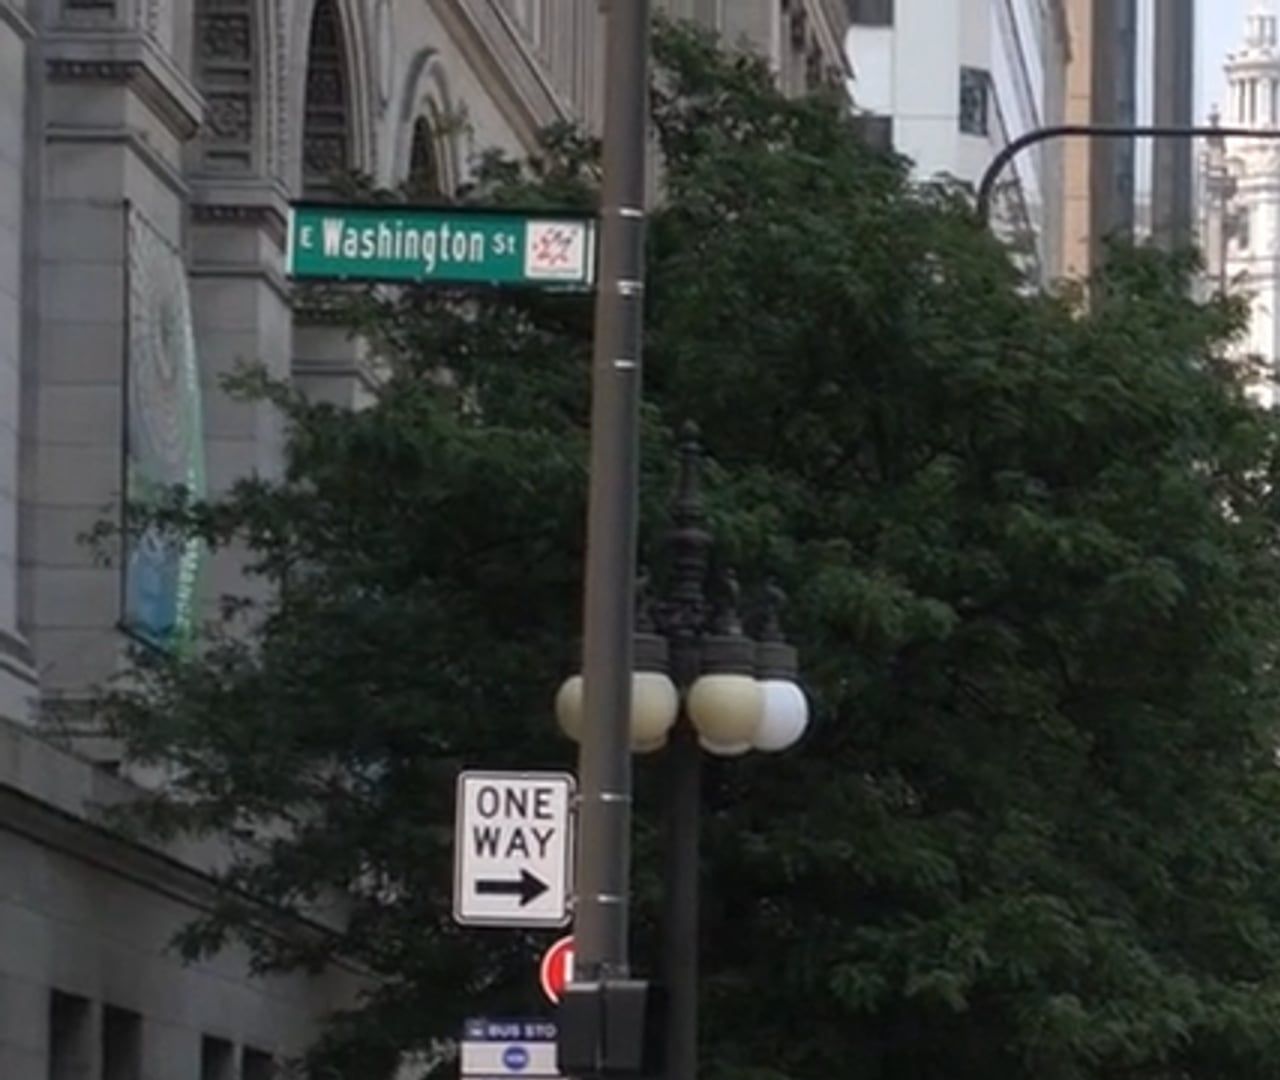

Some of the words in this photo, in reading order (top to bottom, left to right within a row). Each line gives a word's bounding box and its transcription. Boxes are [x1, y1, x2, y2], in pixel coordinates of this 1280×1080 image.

[300, 225, 313, 248] E
[322, 216, 485, 275] Washington
[491, 231, 518, 256] St
[476, 785, 554, 820] ONE
[473, 826, 555, 858] WAY
[488, 1023, 521, 1038] BUS
[524, 1023, 558, 1038] STO
